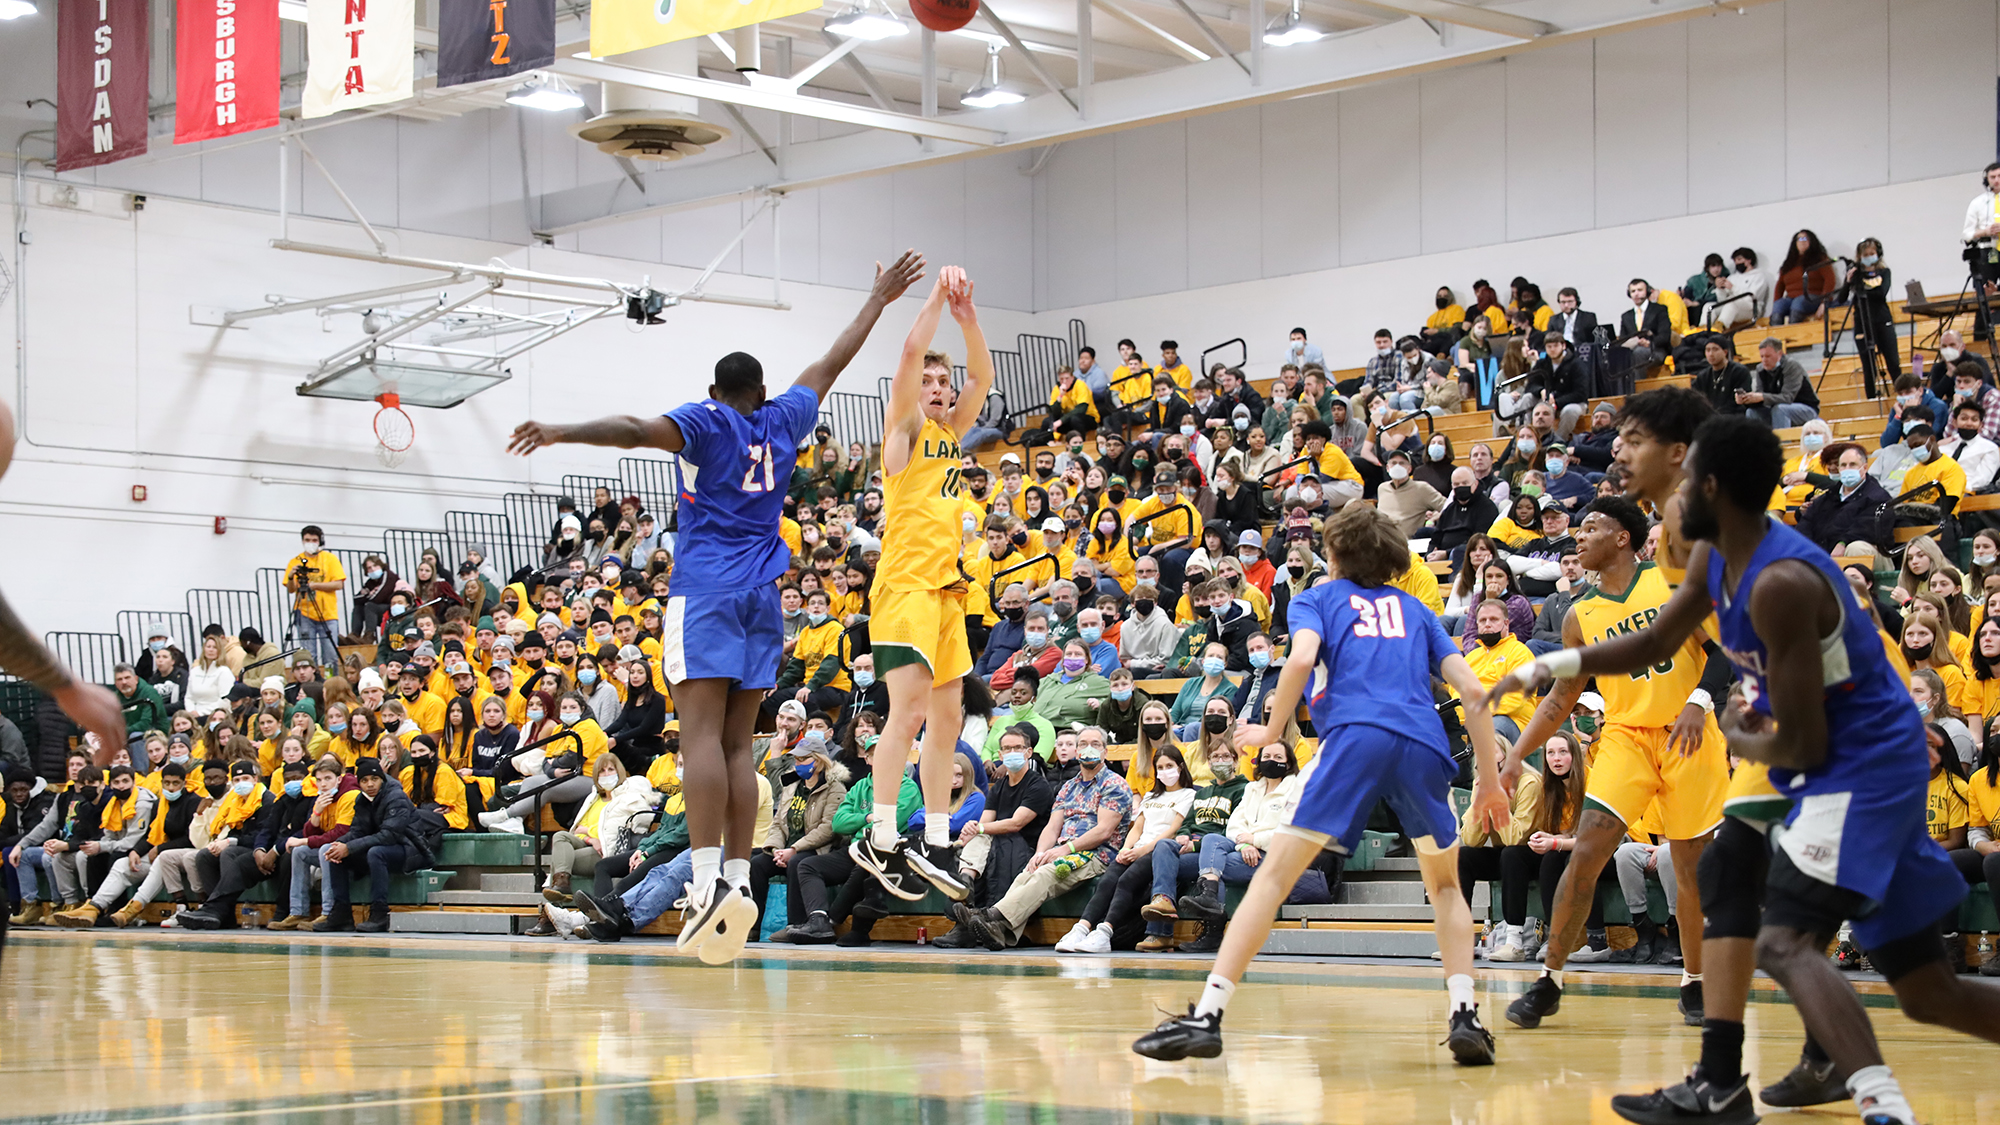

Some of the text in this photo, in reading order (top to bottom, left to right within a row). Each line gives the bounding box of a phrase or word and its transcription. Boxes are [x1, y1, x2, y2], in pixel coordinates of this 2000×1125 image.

[93, 0, 113, 153] TSDAM
[215, 0, 236, 126] SBURGH
[741, 442, 775, 492] 21
[1349, 594, 1406, 639] 30
